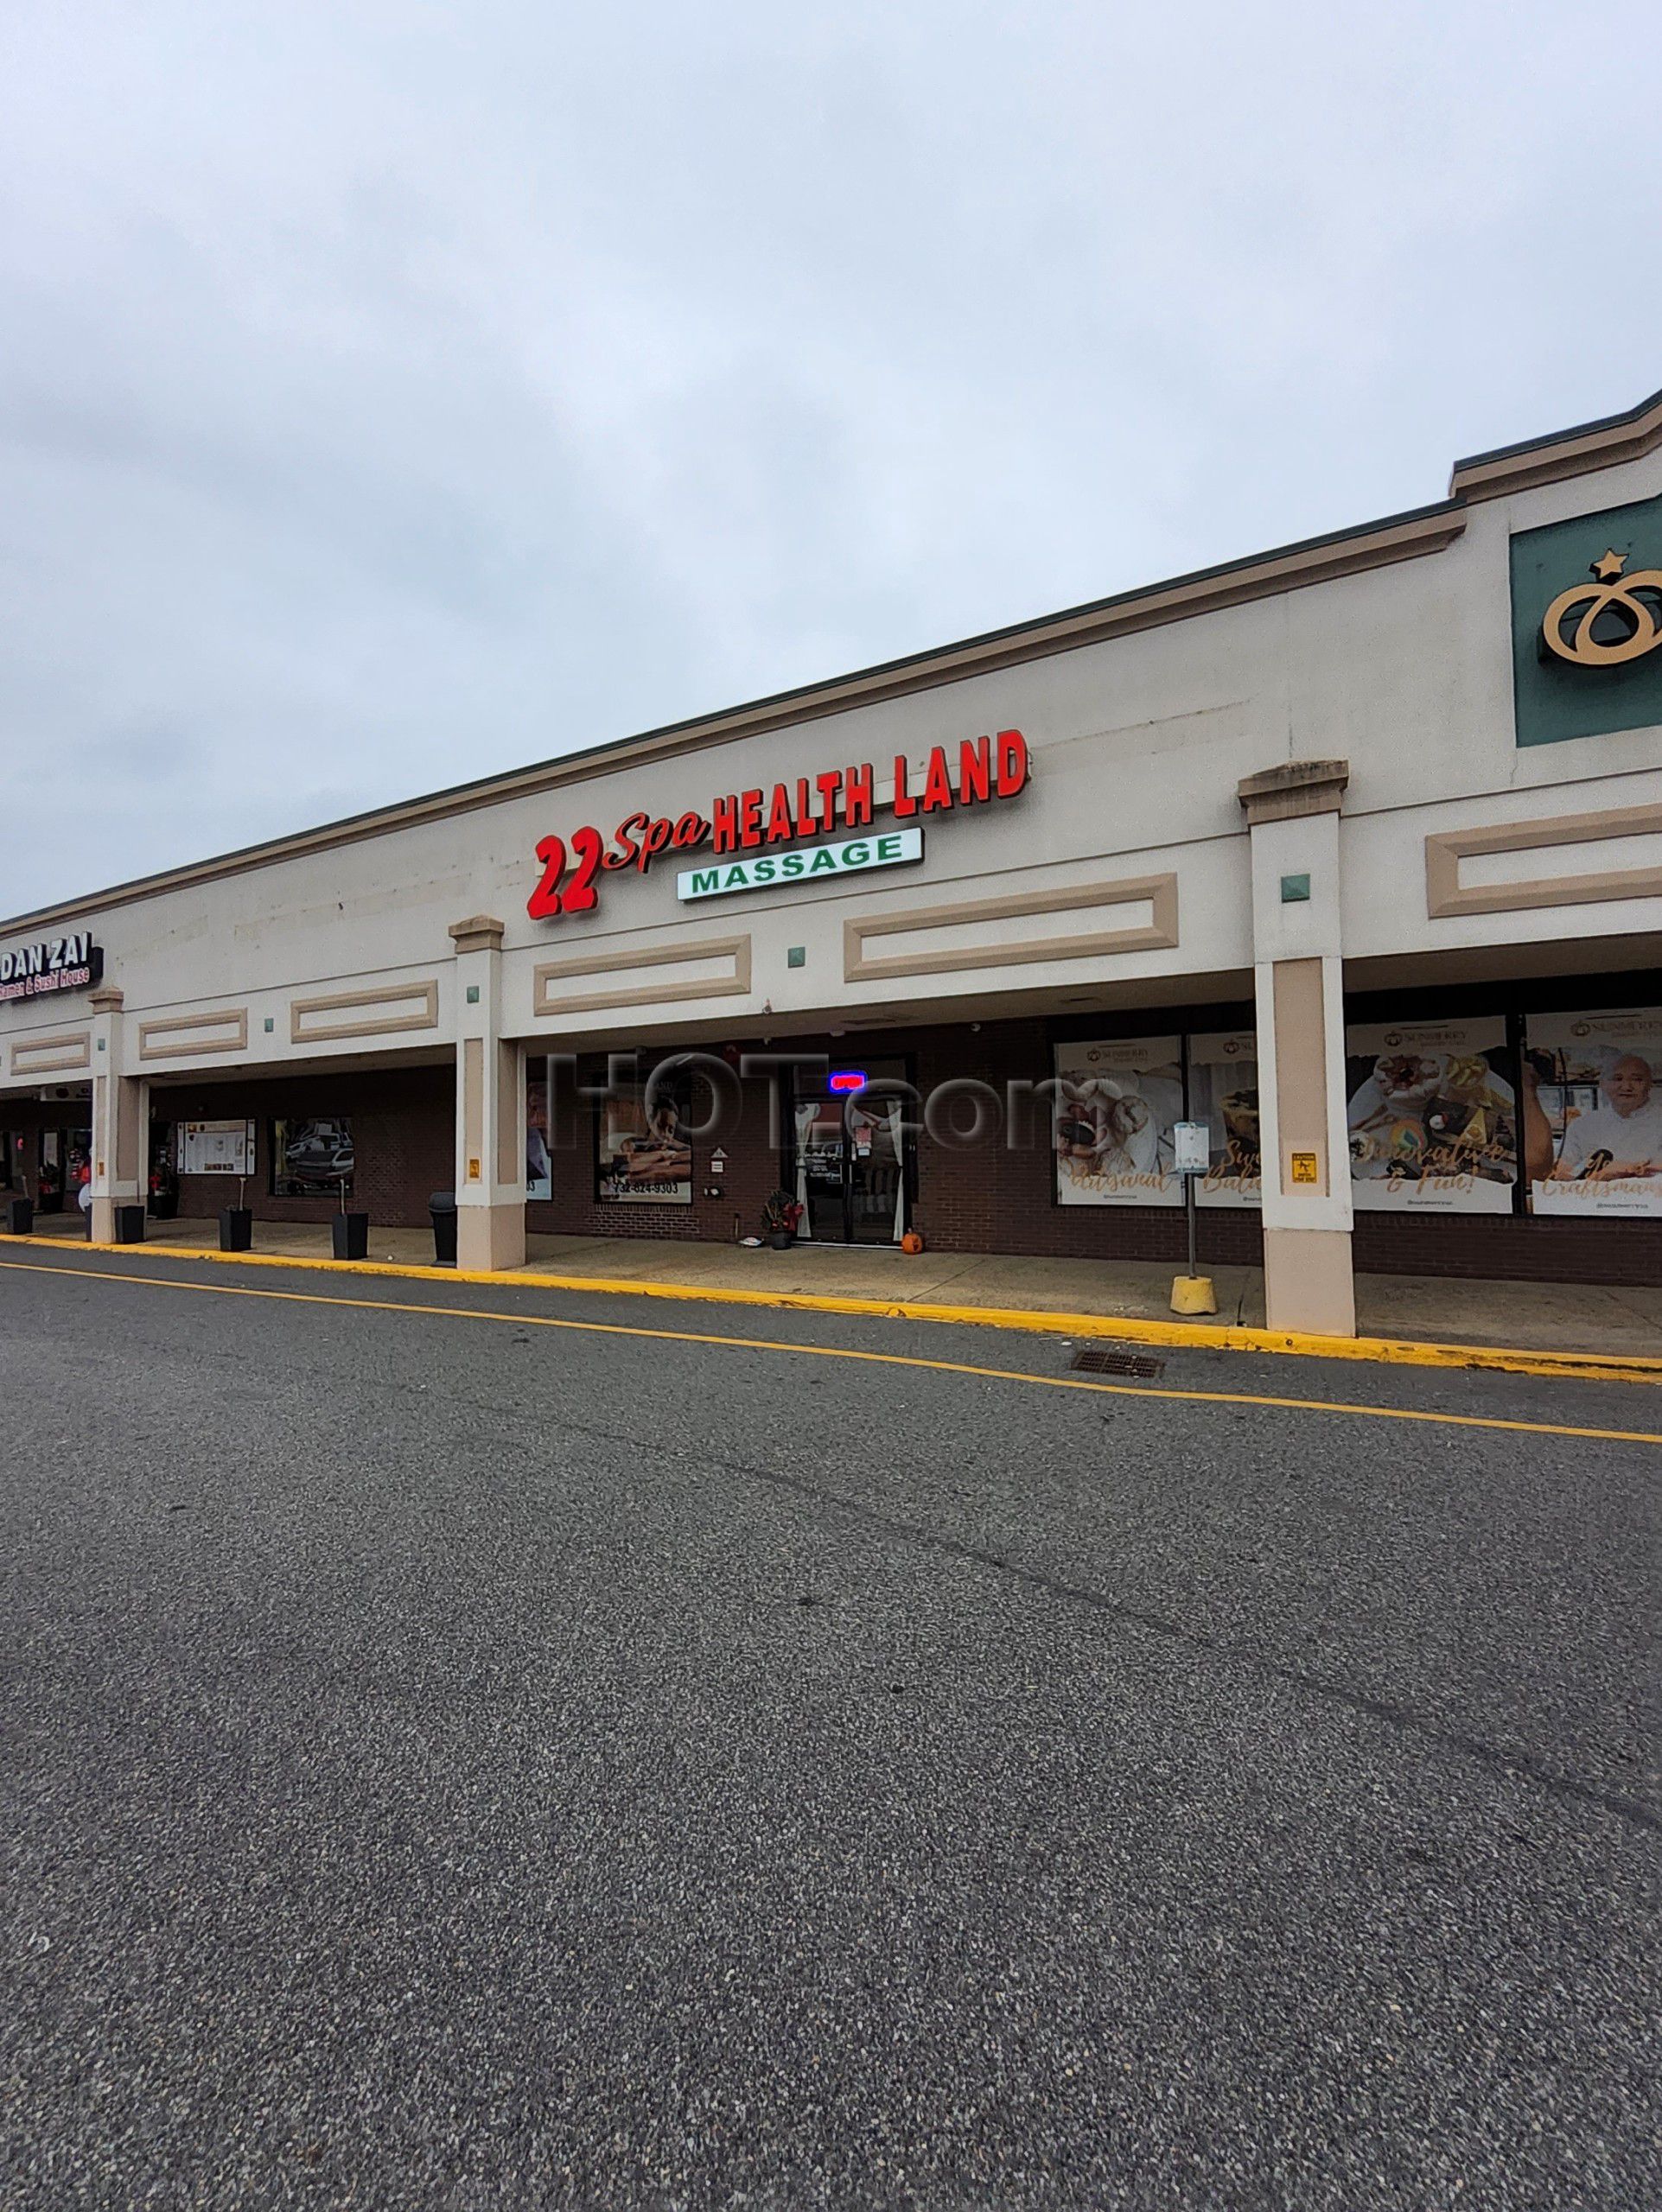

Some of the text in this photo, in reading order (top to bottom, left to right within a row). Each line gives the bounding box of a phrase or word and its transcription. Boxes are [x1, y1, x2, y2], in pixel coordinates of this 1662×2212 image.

[527, 729, 1032, 920] 22 Spa HEALTH LAND
[691, 835, 903, 893] MASSAGE
[34, 969, 60, 993] Sushi
[60, 967, 90, 988] House
[613, 1181, 678, 1194] 732-824-9303
